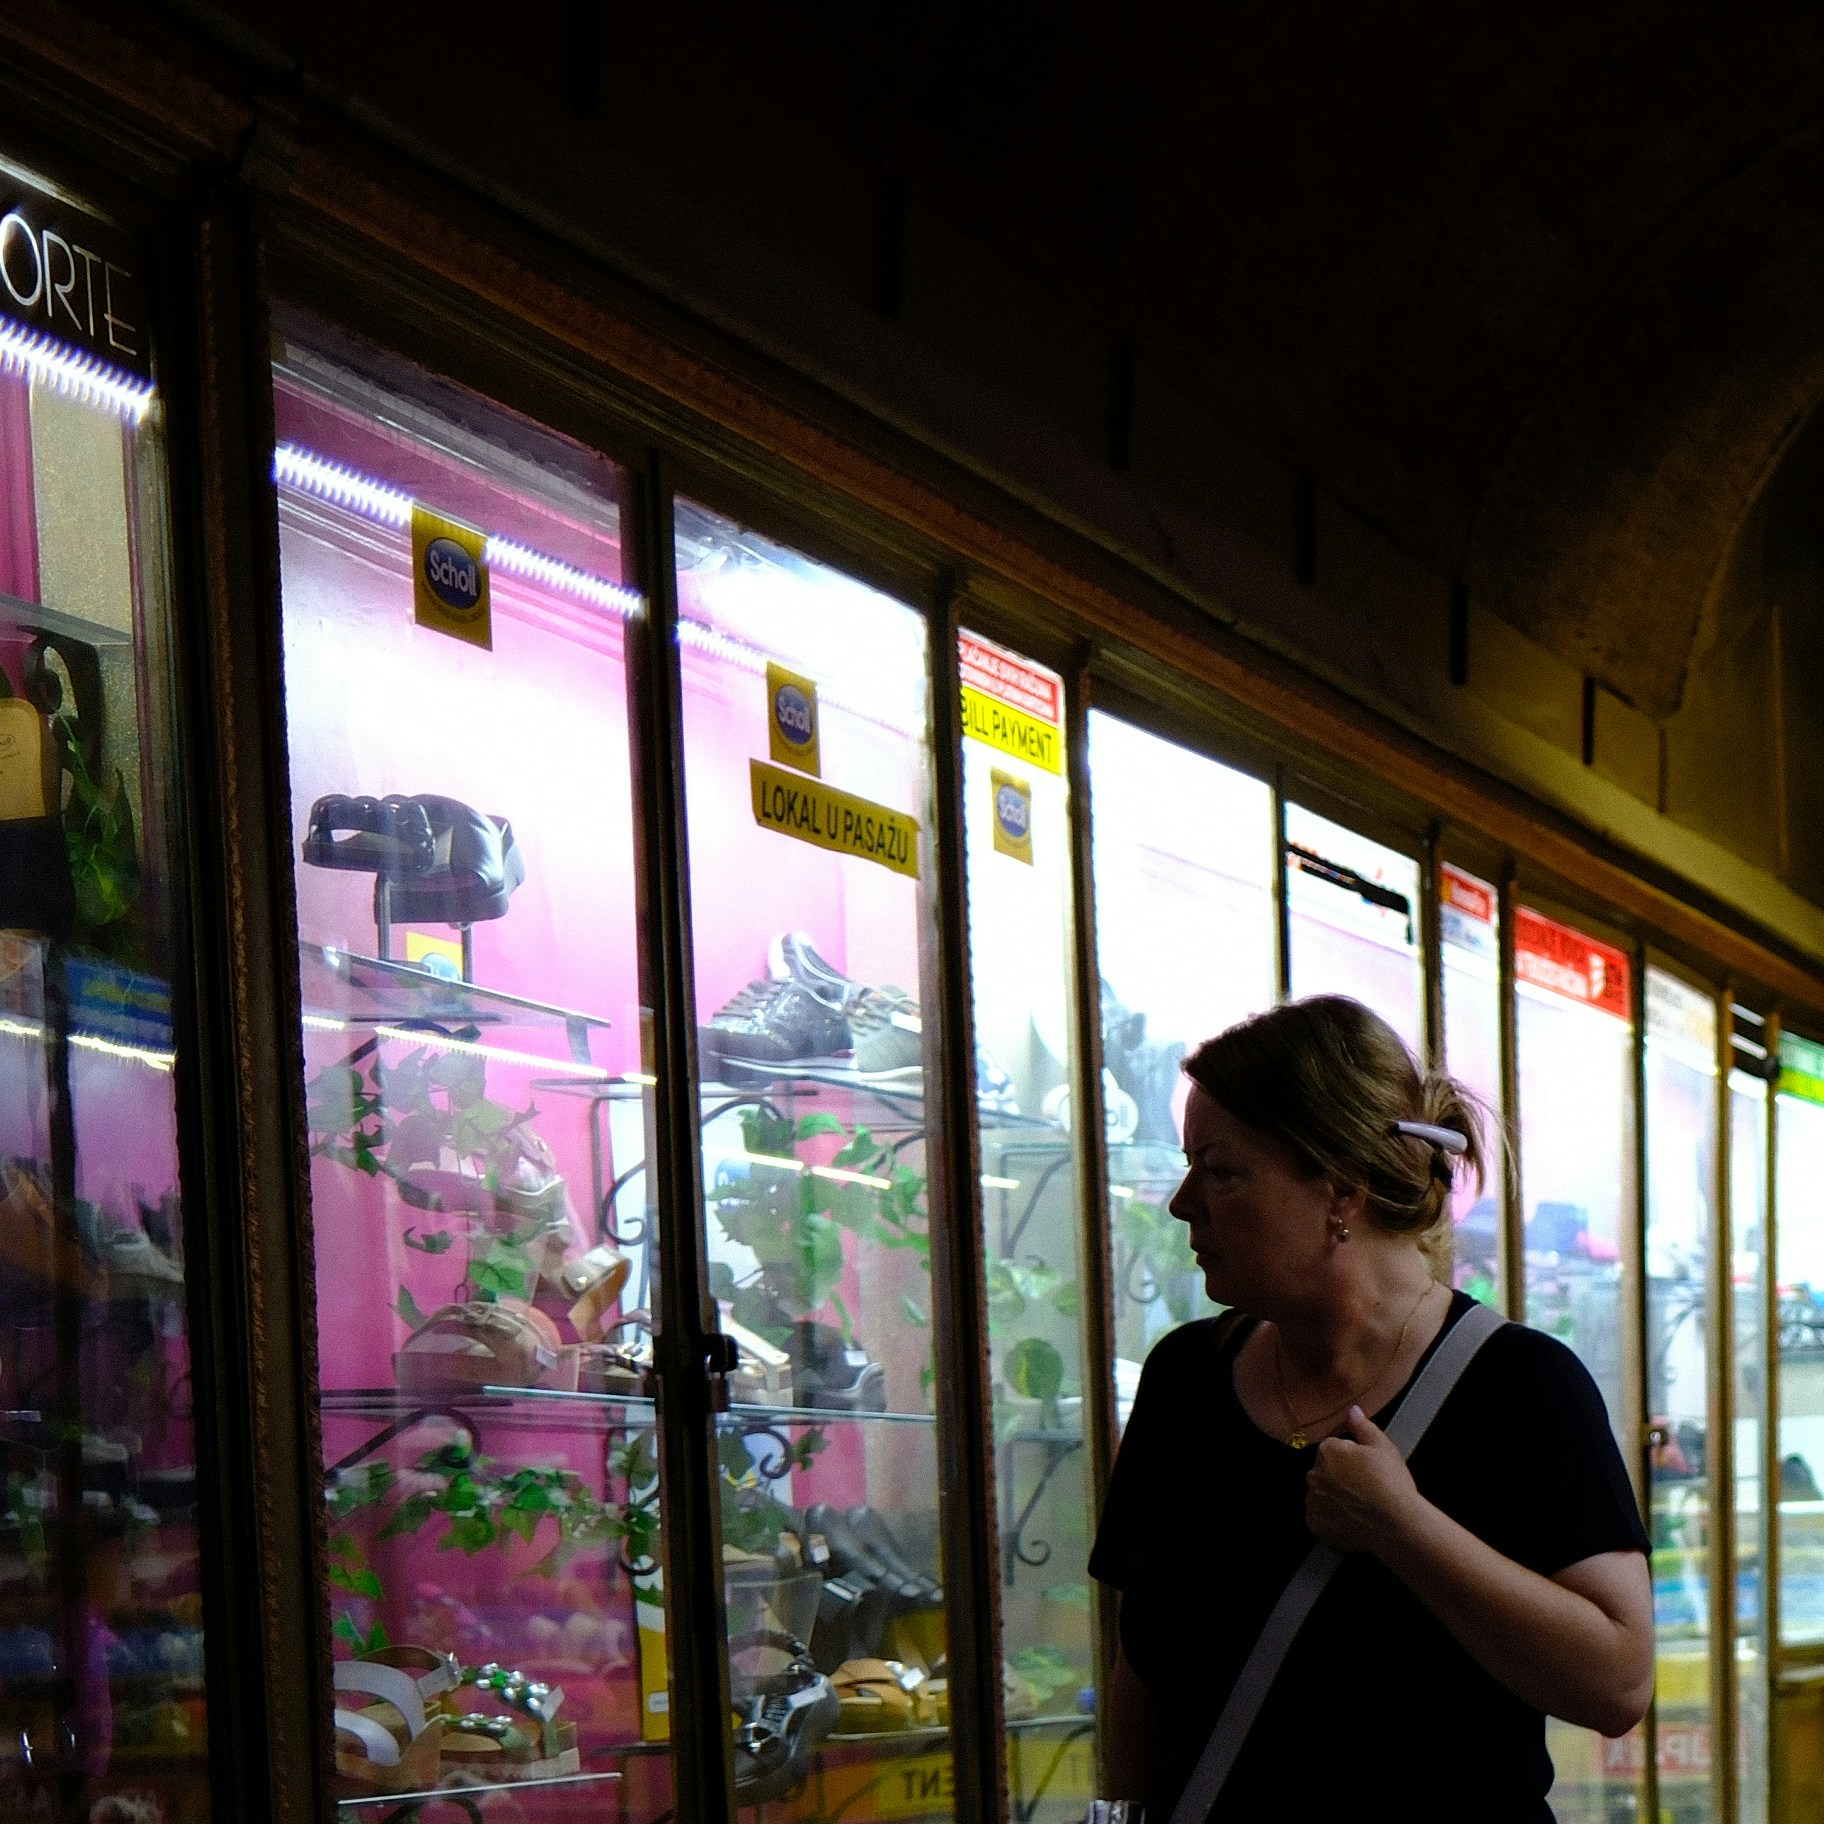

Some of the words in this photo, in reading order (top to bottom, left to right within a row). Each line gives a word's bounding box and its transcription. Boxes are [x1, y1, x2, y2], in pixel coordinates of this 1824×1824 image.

[430, 548, 477, 597] Scholl
[992, 708, 1053, 765] PAYMENT
[761, 780, 822, 835] LOKAL
[827, 803, 839, 841] U
[844, 810, 909, 865] PASAŽU
